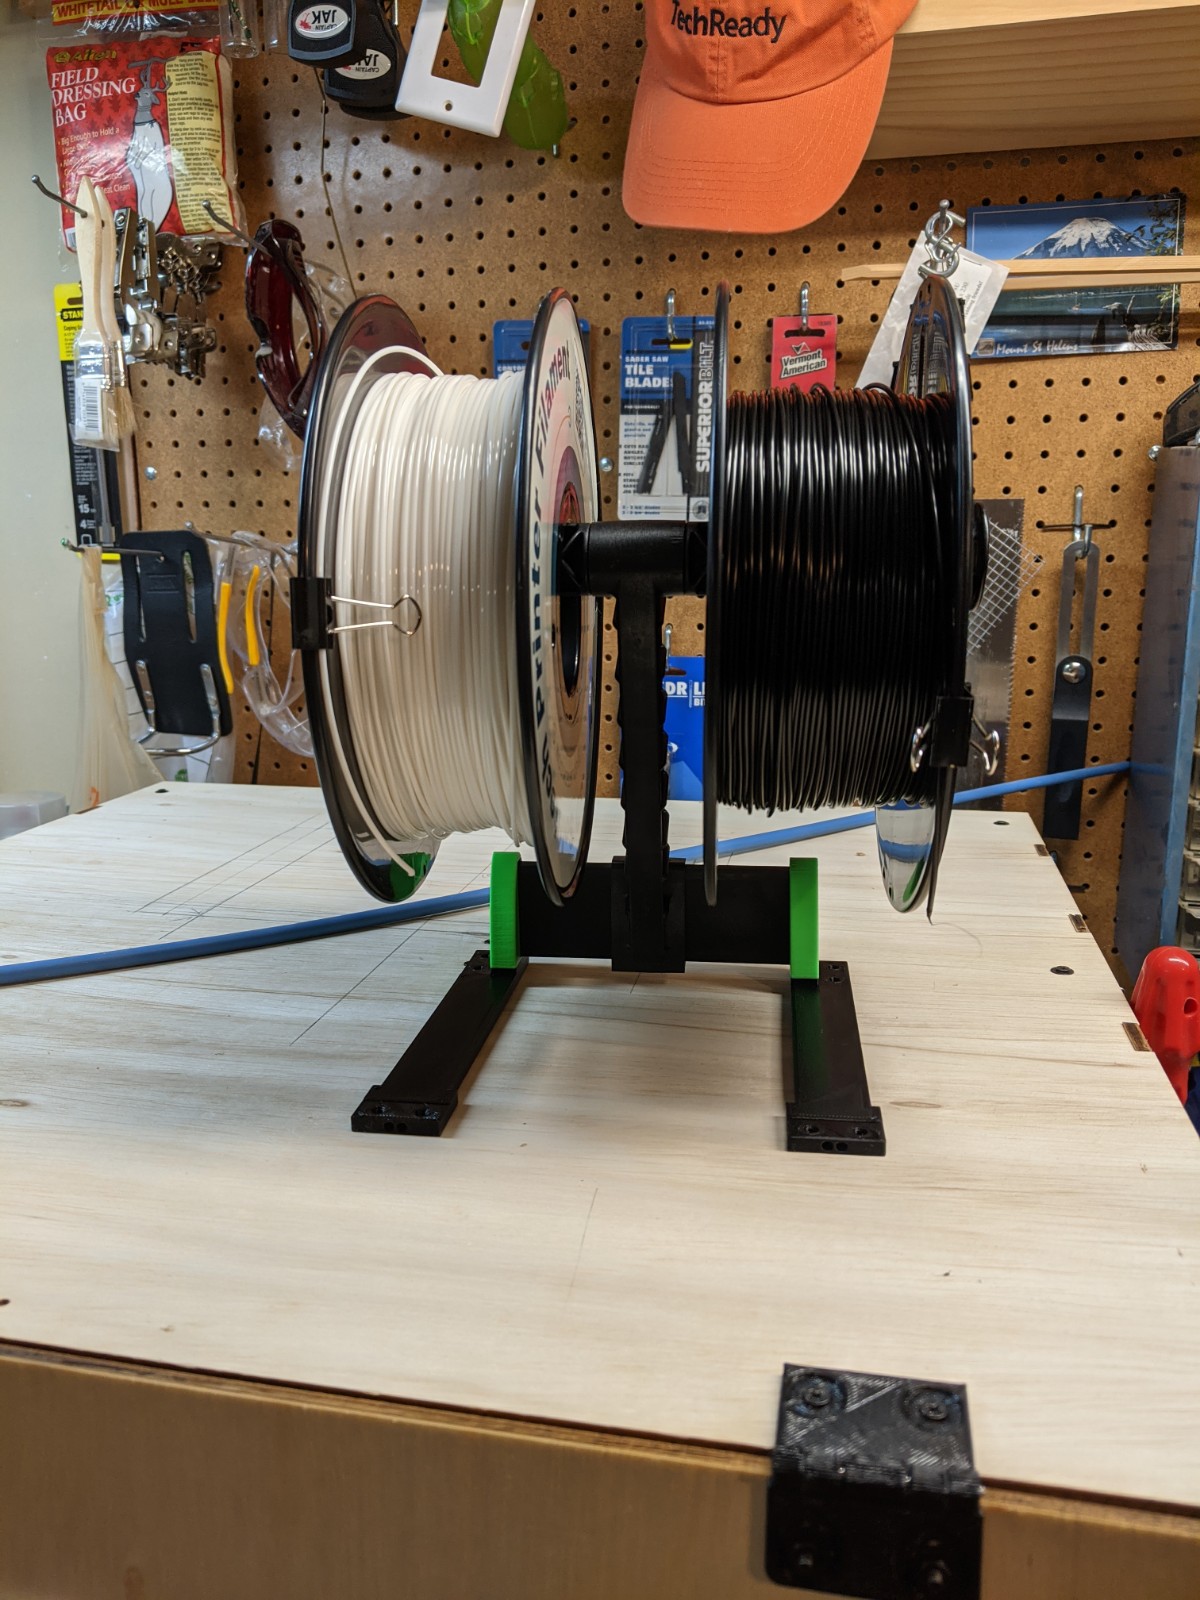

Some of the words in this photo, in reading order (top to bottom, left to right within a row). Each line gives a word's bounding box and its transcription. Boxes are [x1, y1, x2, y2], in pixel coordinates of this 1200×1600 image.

[57, 0, 120, 17] WHITETAIL
[311, 10, 337, 24] JAK
[670, 0, 788, 43] TechReady
[357, 54, 379, 66] JA
[51, 67, 99, 88] FIELD
[51, 78, 136, 107] DRESSING
[55, 103, 87, 127] BAG
[100, 127, 114, 135] Hold
[63, 310, 83, 320] STAN
[996, 342, 1028, 355] Mount
[1047, 339, 1078, 352] Helens
[783, 350, 821, 367] Vermont
[624, 363, 654, 375] TILE
[782, 360, 826, 376] American
[535, 340, 570, 478] Filament
[531, 487, 545, 729] Printer
